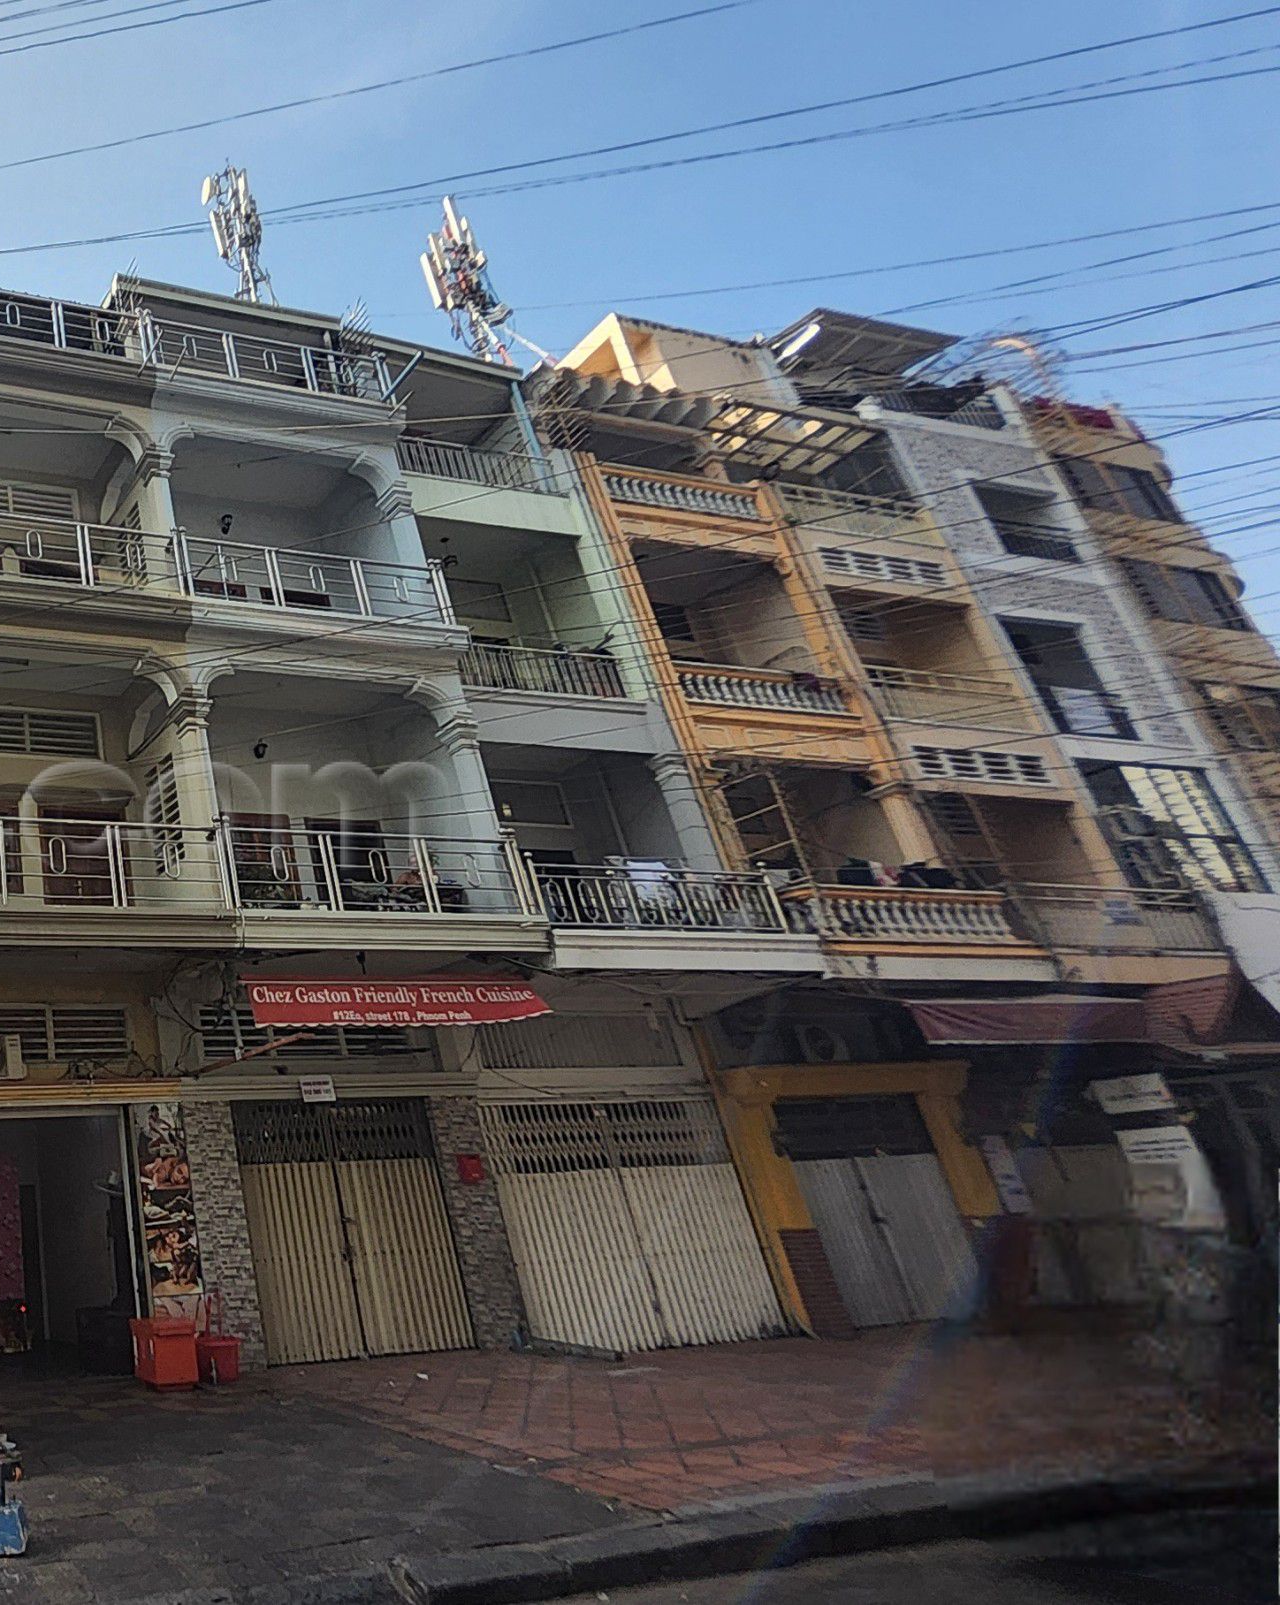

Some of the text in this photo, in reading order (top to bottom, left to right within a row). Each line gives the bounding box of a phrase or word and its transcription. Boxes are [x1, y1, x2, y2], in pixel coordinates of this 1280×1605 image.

[252, 985, 536, 1009] Chez Gaston Friendly French Cuisine
[416, 1010, 448, 1021] Phnom
[448, 1010, 473, 1020] Penh
